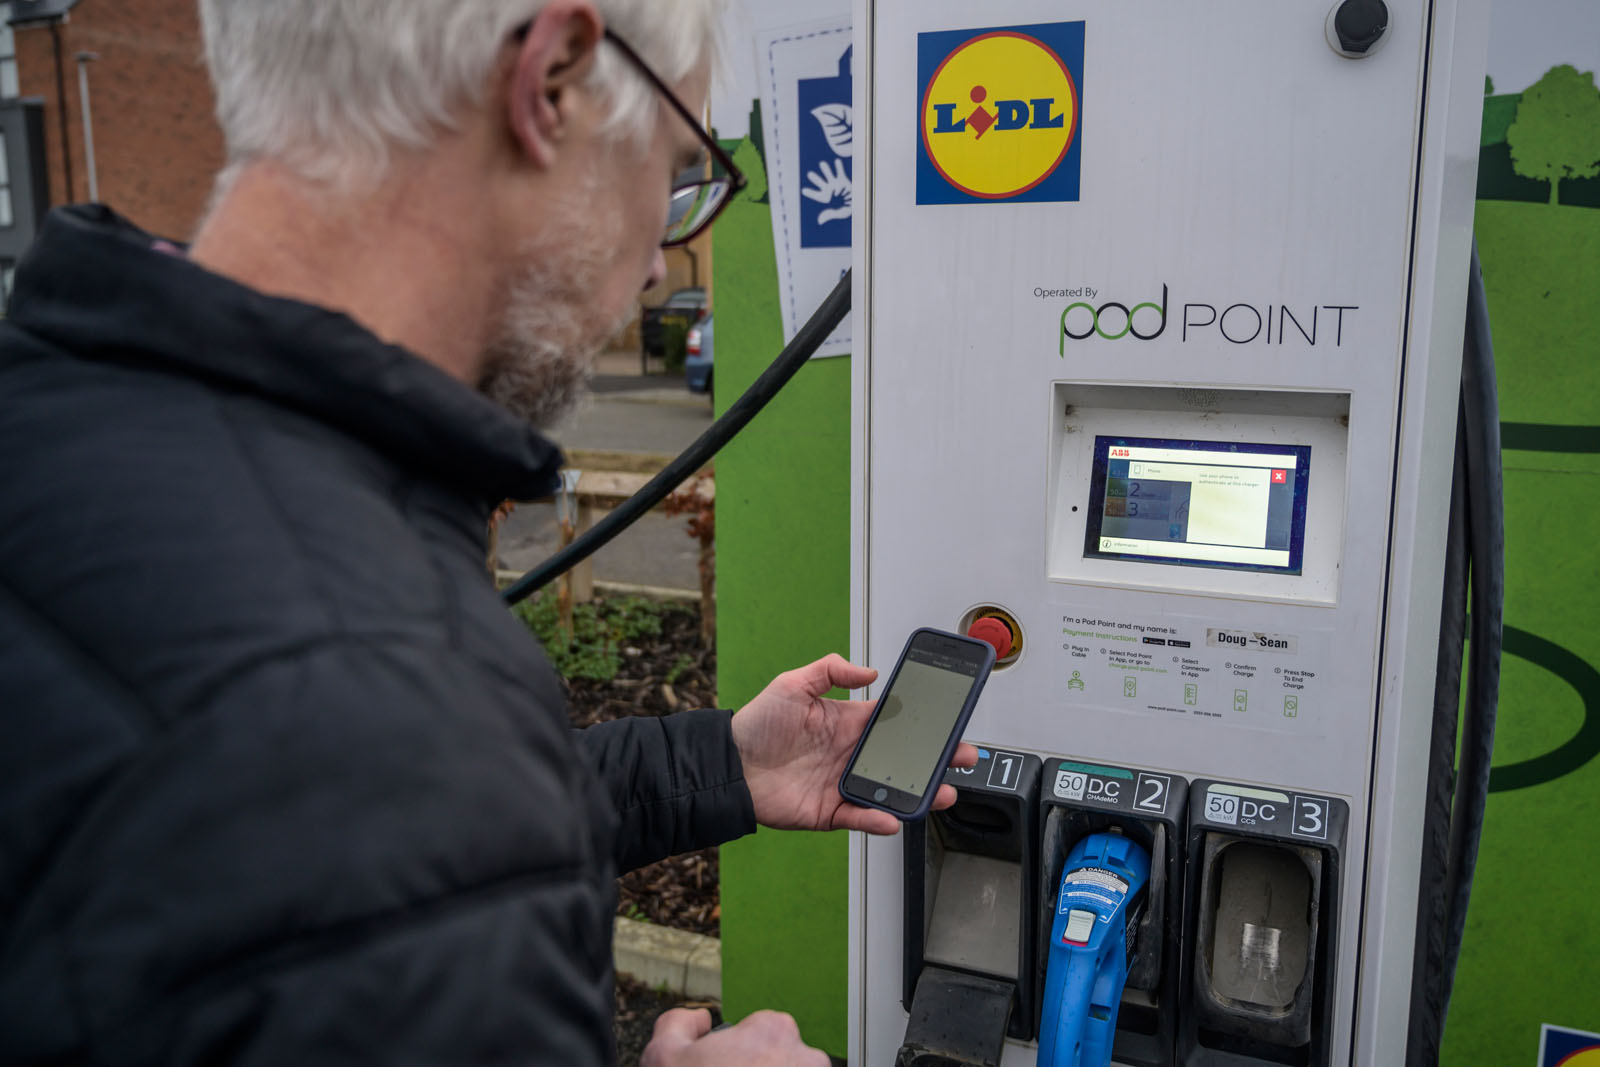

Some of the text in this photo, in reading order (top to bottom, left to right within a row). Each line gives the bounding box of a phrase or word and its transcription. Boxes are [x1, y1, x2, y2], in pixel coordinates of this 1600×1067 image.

[1033, 287, 1098, 300] Operated By
[1059, 282, 1360, 360] pod POINT
[1130, 482, 1140, 497] 2
[1128, 502, 1138, 516] 3
[1097, 620, 1116, 628] Point
[1063, 628, 1138, 643] Payment Instructions
[1218, 632, 1247, 647] Doug
[1260, 636, 1288, 649] Sean
[1283, 682, 1304, 690] Charge
[1002, 758, 1013, 784] 1
[1058, 774, 1163, 809] 50 DC 2
[1086, 794, 1118, 804] CHAdeMO
[1209, 798, 1322, 832] 50 DC 3
[1088, 868, 1118, 878] DANGER
